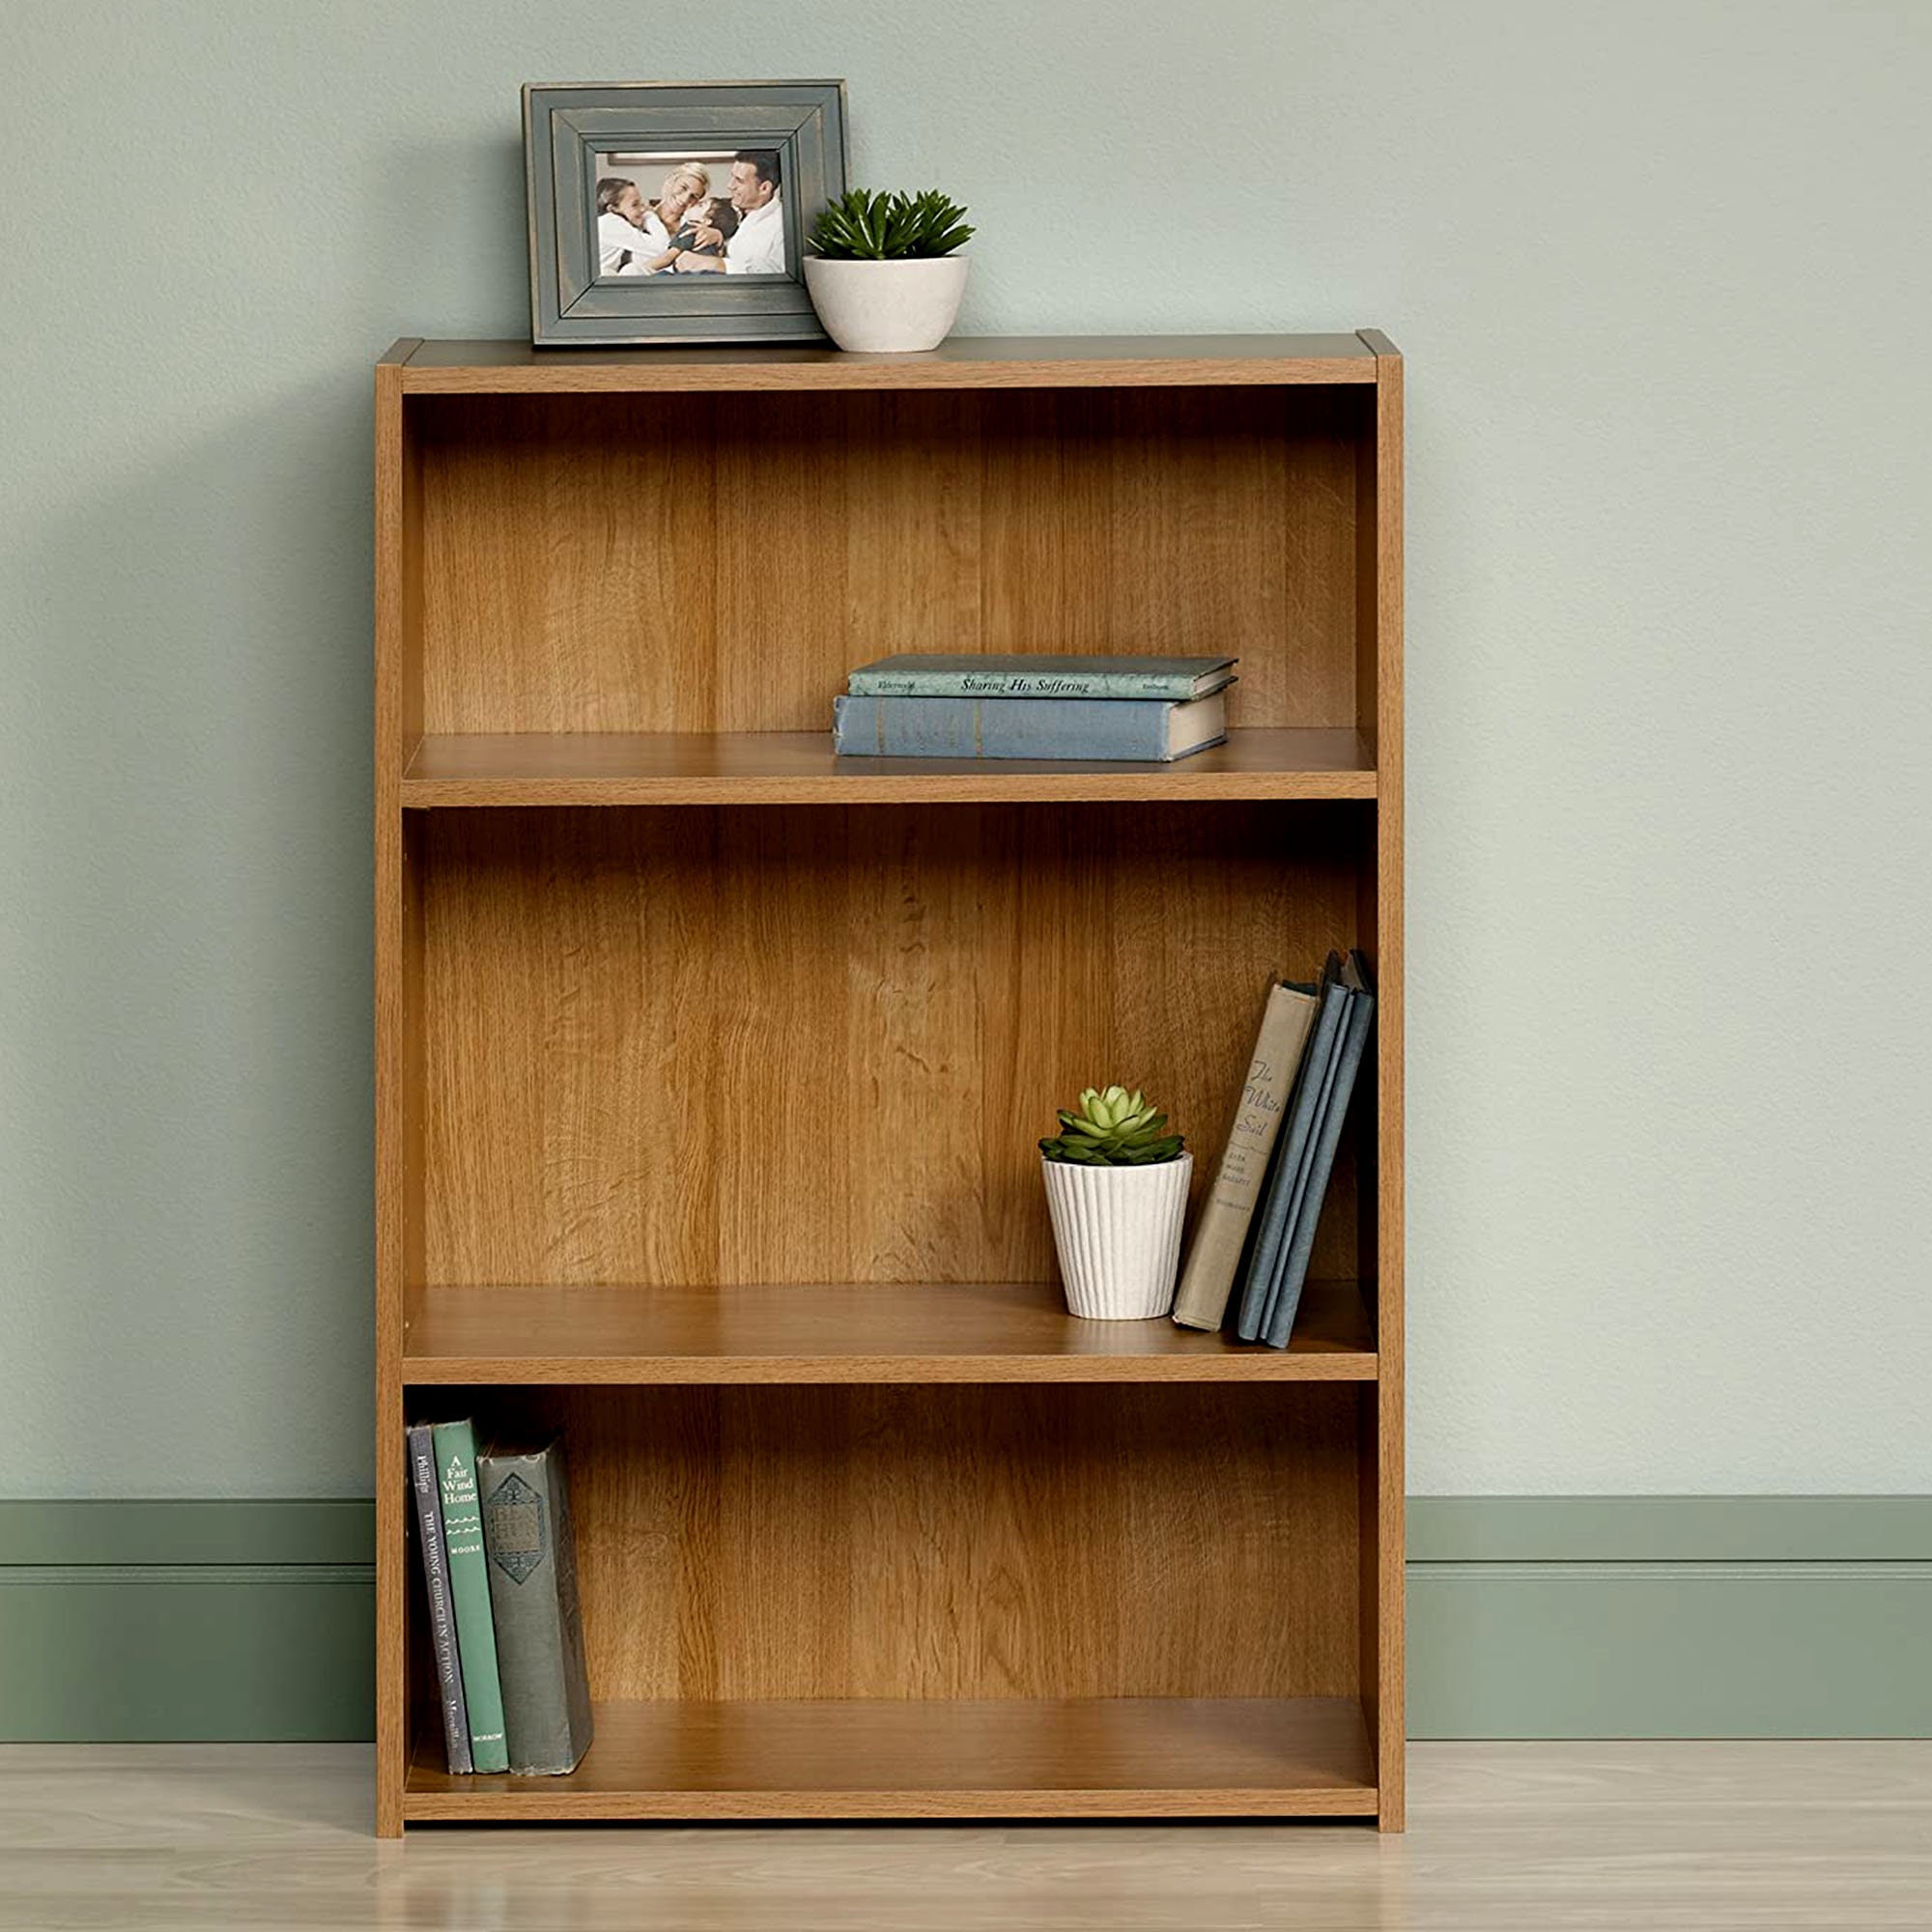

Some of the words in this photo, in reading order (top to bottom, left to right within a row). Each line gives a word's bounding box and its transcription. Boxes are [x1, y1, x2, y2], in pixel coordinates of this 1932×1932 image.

[961, 678, 1006, 693] Sharing
[1009, 679, 1032, 691] His
[1037, 679, 1090, 693] Suffering
[1251, 1060, 1272, 1081] The
[1243, 1085, 1283, 1113] White
[1236, 1114, 1267, 1136] Sail
[451, 1455, 462, 1467] A
[415, 1455, 431, 1493] Phillips
[446, 1467, 469, 1479] Fair
[443, 1478, 473, 1492] Wind
[444, 1492, 477, 1505] Home
[424, 1511, 437, 1534] THE
[428, 1536, 440, 1575] YOUNG
[433, 1577, 445, 1622] CHURCH
[440, 1637, 454, 1683] ACTION
